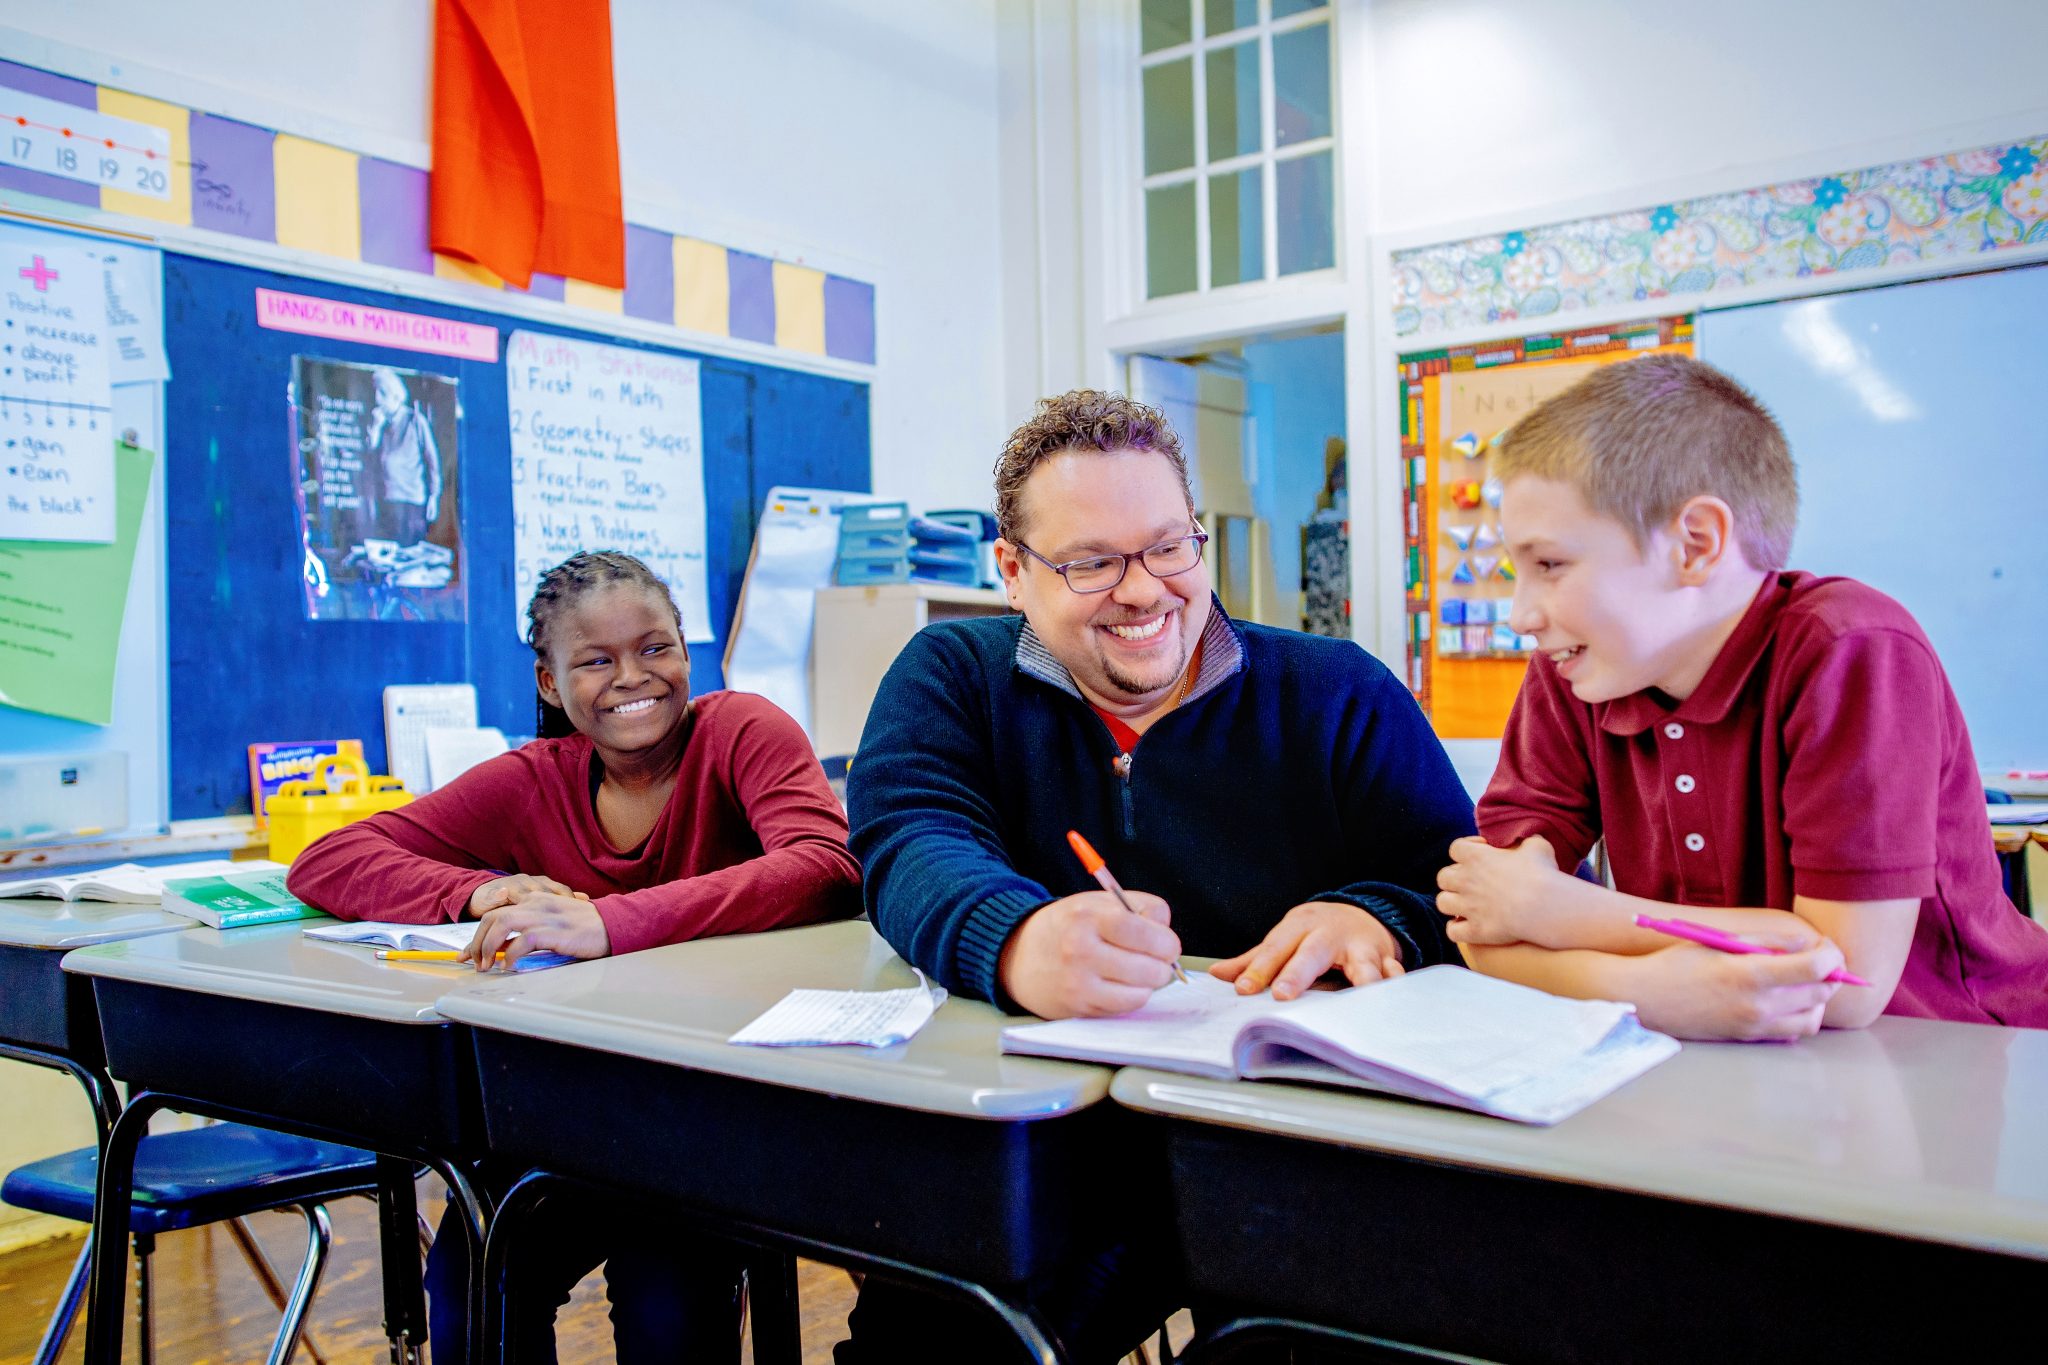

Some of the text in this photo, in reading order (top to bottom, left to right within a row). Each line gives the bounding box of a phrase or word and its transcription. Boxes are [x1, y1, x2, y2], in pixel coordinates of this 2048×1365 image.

[13, 136, 167, 192] 17 18 19 20
[25, 324, 98, 347] increase
[267, 296, 471, 348] HANDS ON MATH CENTER
[21, 343, 76, 366] above
[517, 334, 580, 372] Math
[528, 366, 573, 395] First
[587, 382, 605, 402] in
[619, 380, 664, 411] Math
[530, 409, 623, 451] Geometry
[638, 424, 693, 459] Shapes
[536, 458, 610, 493] Fraction
[622, 467, 667, 499] Bars
[539, 511, 580, 541] Word
[591, 512, 662, 548] Problems
